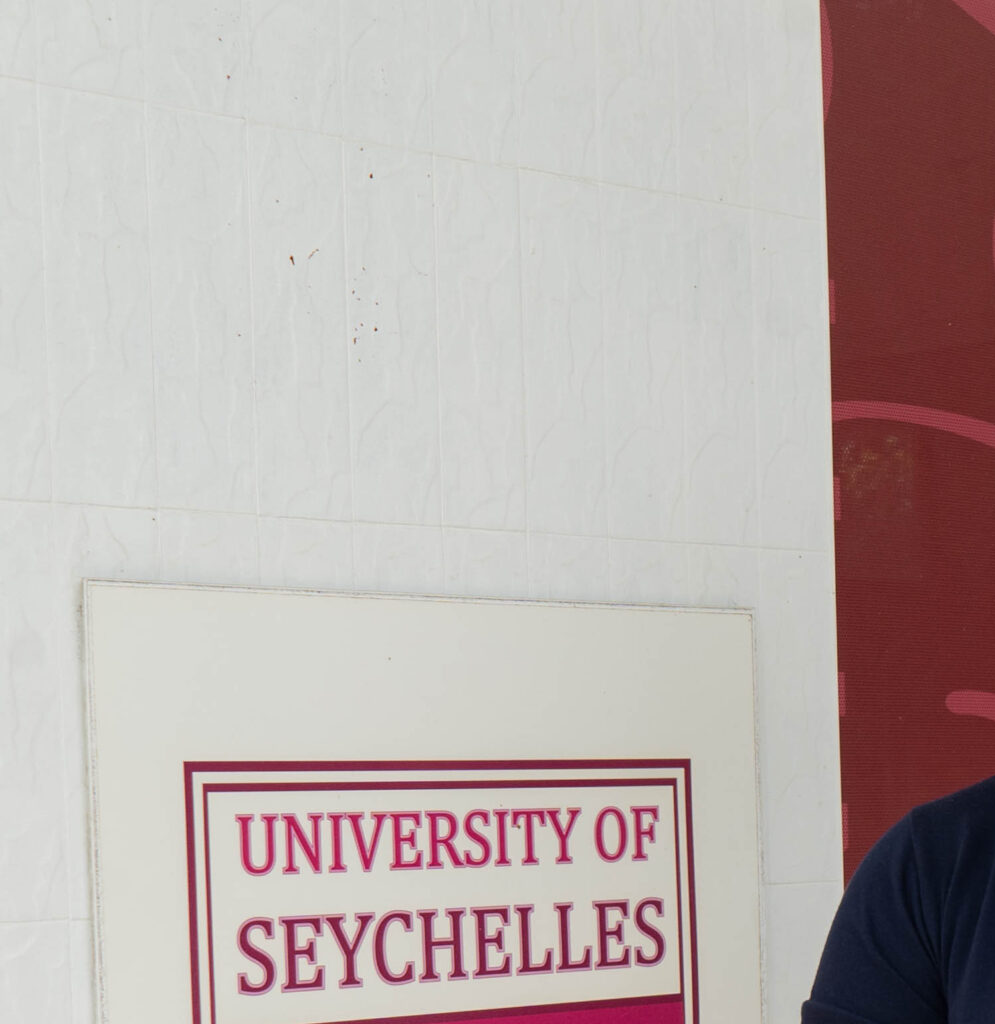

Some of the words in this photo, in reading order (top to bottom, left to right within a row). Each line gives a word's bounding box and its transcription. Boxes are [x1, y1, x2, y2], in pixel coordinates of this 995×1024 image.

[235, 806, 581, 876] UNIVERSITY
[593, 805, 660, 863] OF
[236, 897, 667, 996] SEYCHELLES
